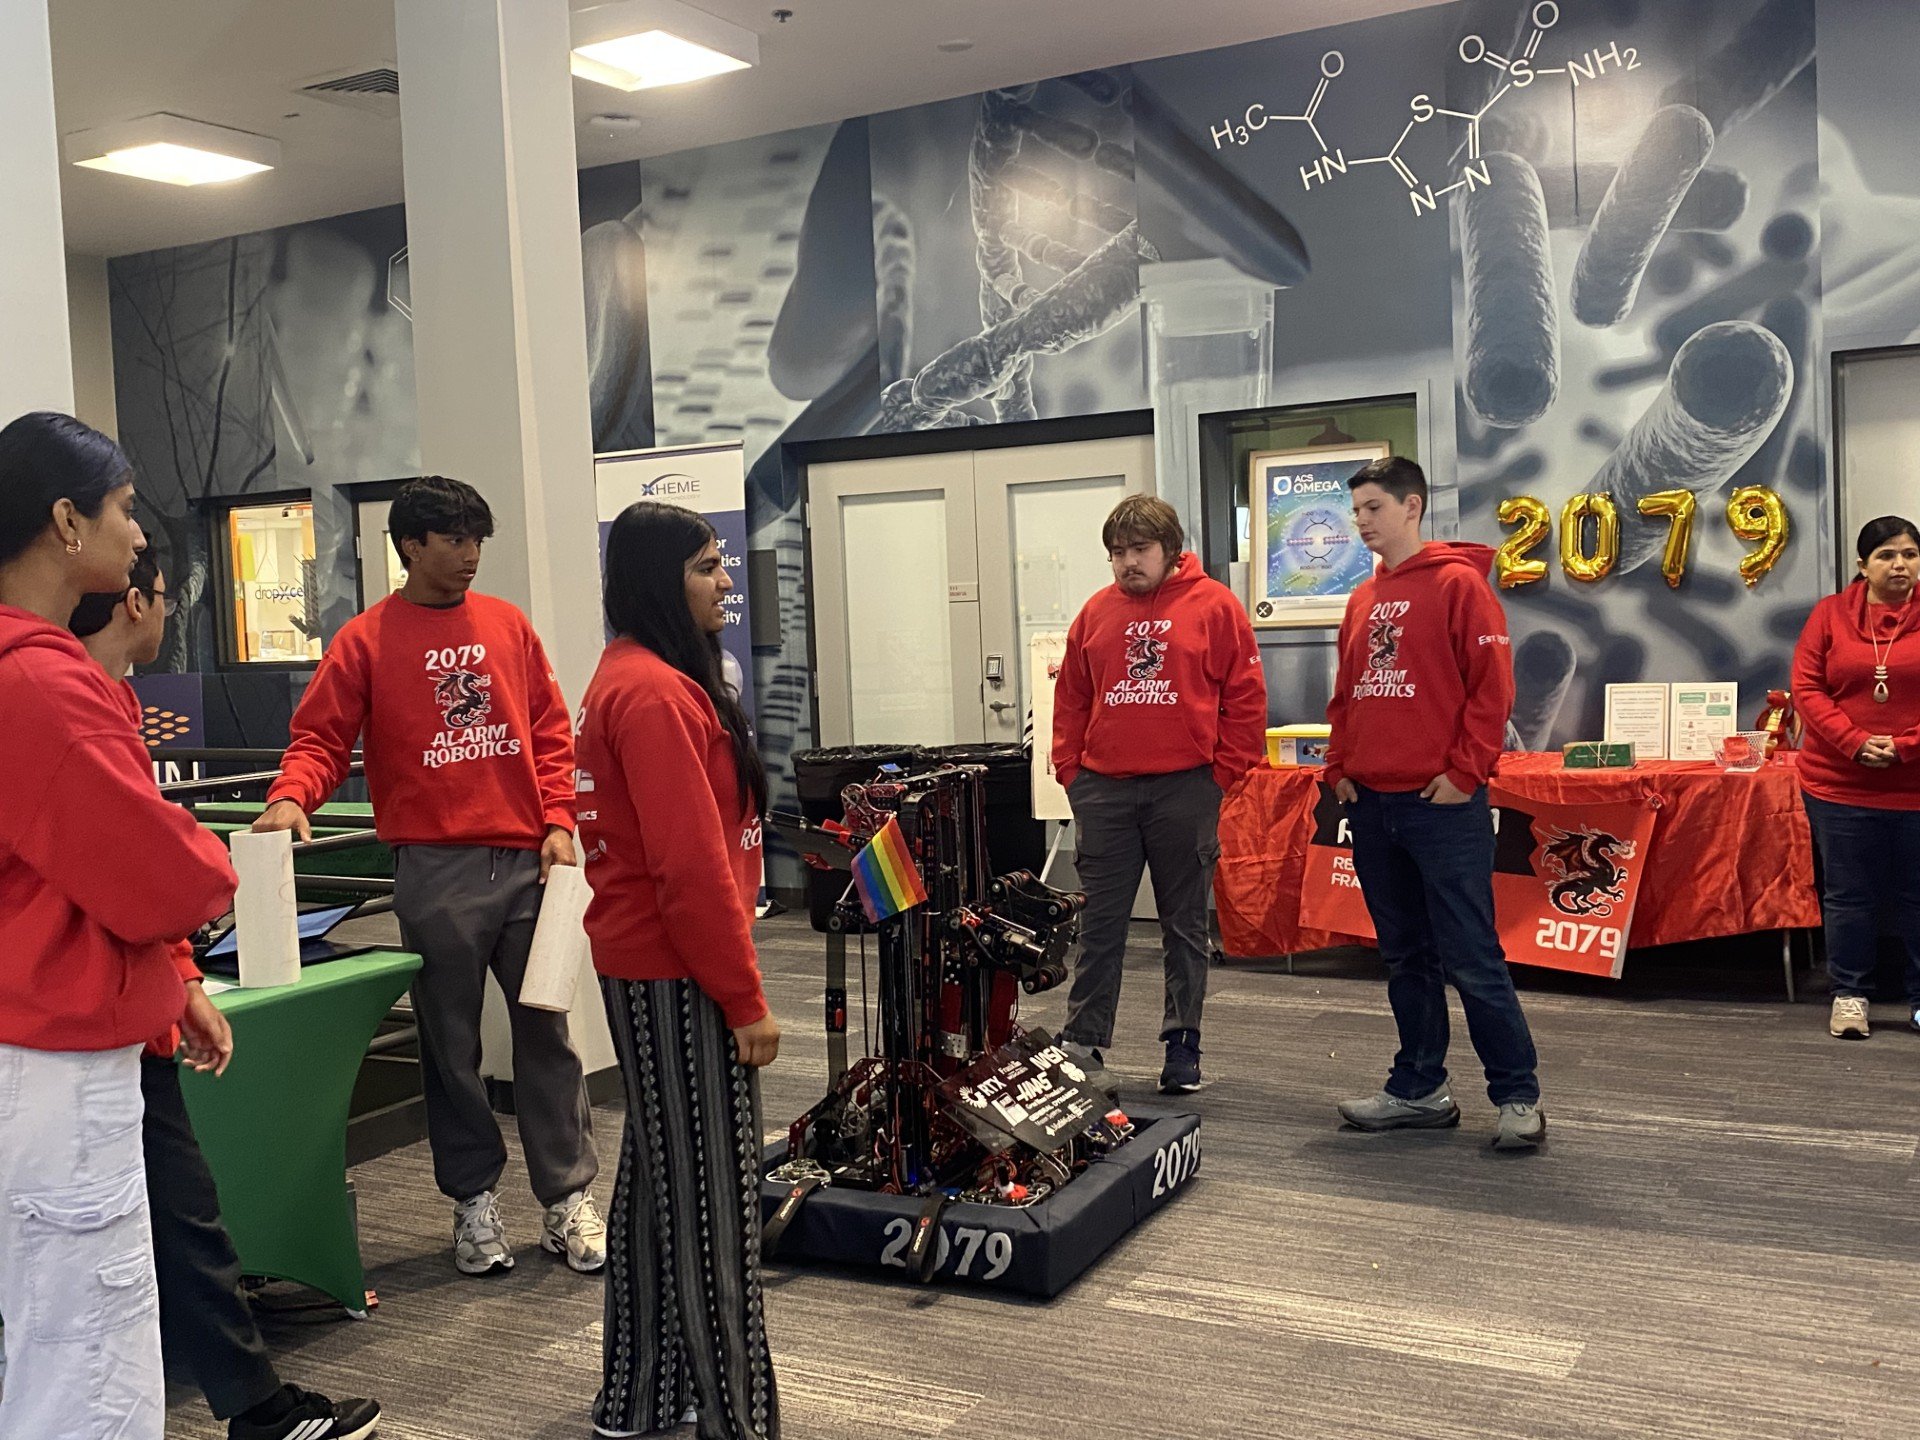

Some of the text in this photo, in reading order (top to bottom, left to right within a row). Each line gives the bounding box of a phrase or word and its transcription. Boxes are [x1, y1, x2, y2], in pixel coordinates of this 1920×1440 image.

[1293, 474, 1314, 483] ACS
[1293, 480, 1342, 494] OMEGA
[1496, 484, 1789, 589] 2079
[720, 555, 741, 567] tics
[1368, 600, 1411, 620] 2079
[1124, 619, 1173, 636] 2079
[424, 643, 487, 671] 2079
[1112, 679, 1173, 692] ALARM
[1359, 669, 1408, 684] ALARM
[1104, 691, 1179, 707] ROBOTICS
[1352, 683, 1416, 700] ROBOTICS
[430, 723, 509, 748] ALARM
[422, 738, 522, 769] ROBOTICS
[1535, 918, 1622, 959] 2079
[1029, 1045, 1069, 1071] NASA
[977, 1075, 1007, 1097] RTX
[1152, 1126, 1201, 1199] 2079
